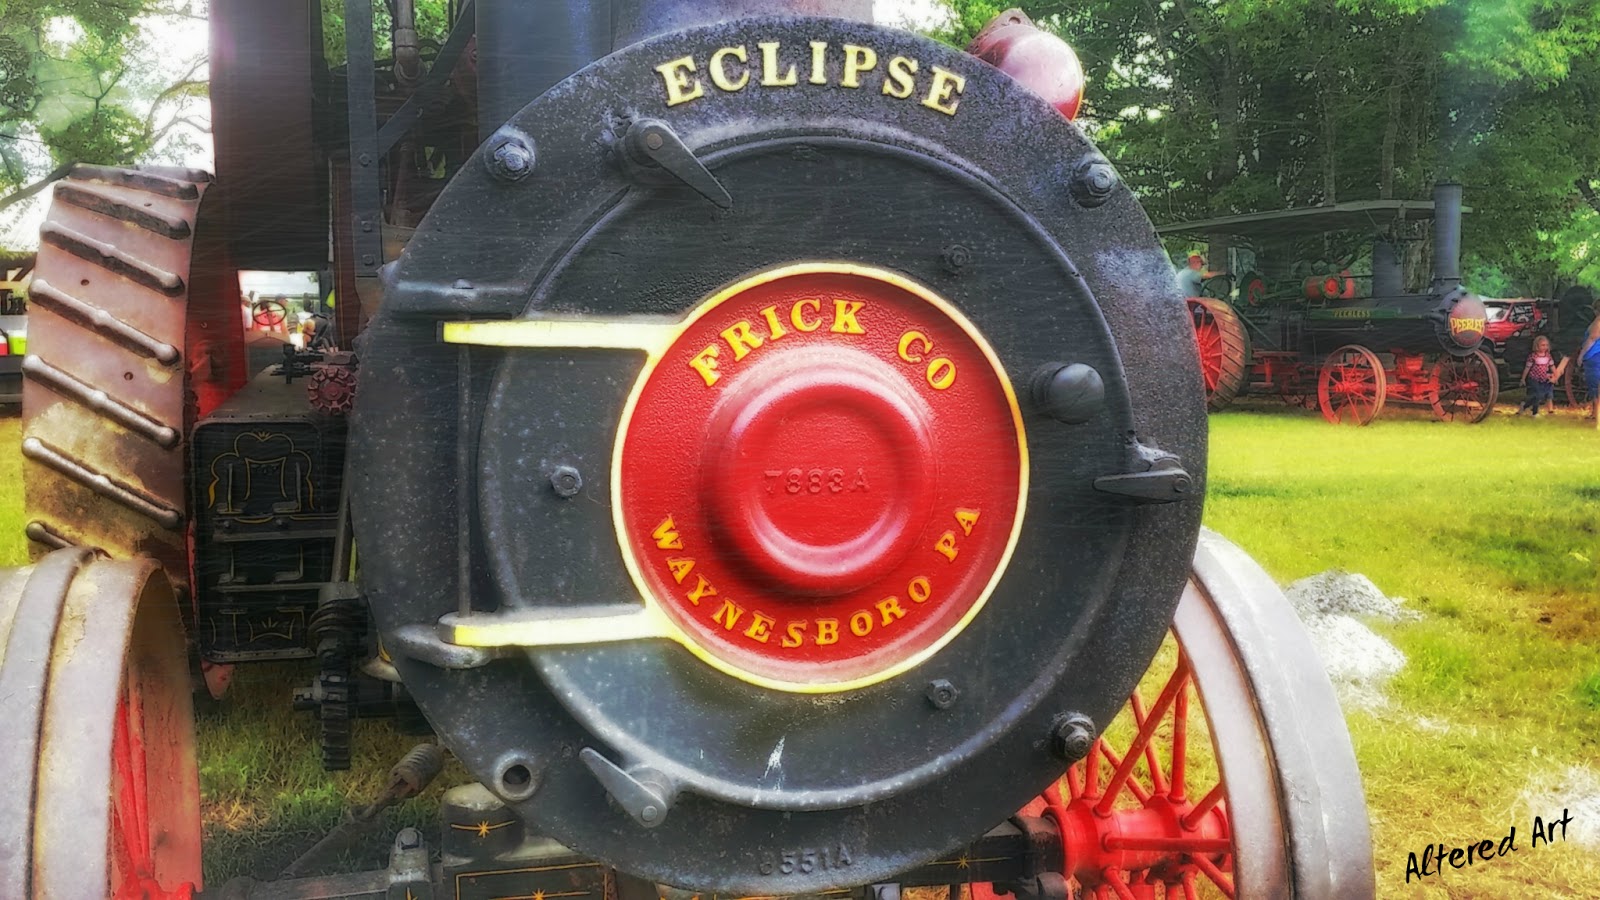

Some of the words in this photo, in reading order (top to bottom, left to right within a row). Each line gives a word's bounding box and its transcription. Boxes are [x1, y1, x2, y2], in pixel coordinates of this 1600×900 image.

[655, 41, 967, 117] ECLIPSE
[688, 298, 867, 388] FRICK
[897, 330, 958, 391] CO
[651, 513, 932, 649] WAYNESBORO
[935, 506, 982, 562] PA
